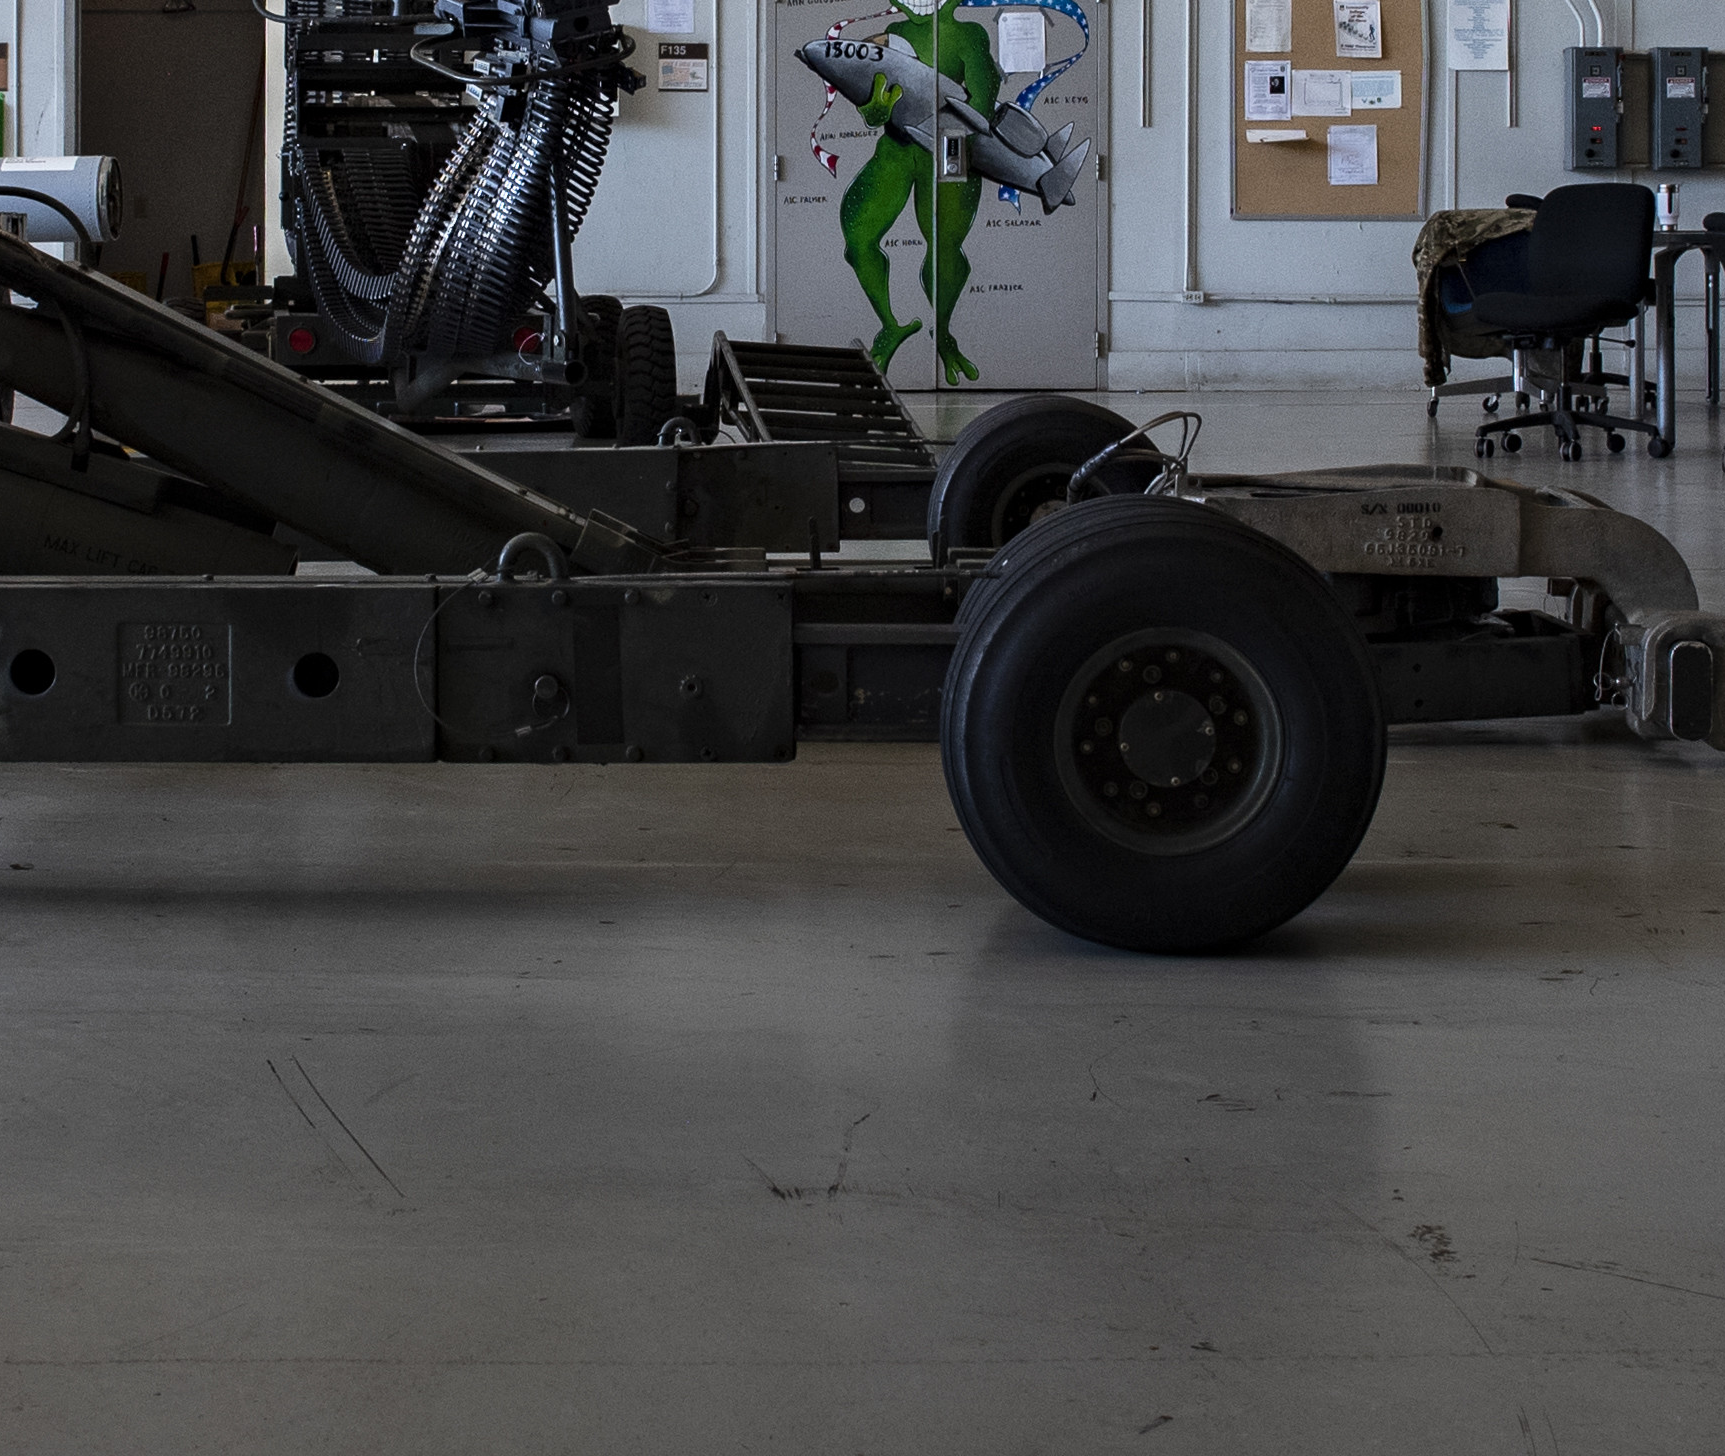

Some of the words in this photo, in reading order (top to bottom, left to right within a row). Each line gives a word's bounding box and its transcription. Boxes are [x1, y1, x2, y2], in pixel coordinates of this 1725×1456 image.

[660, 46, 686, 55] F135
[43, 534, 77, 555] MAX
[85, 547, 122, 569] LIFT
